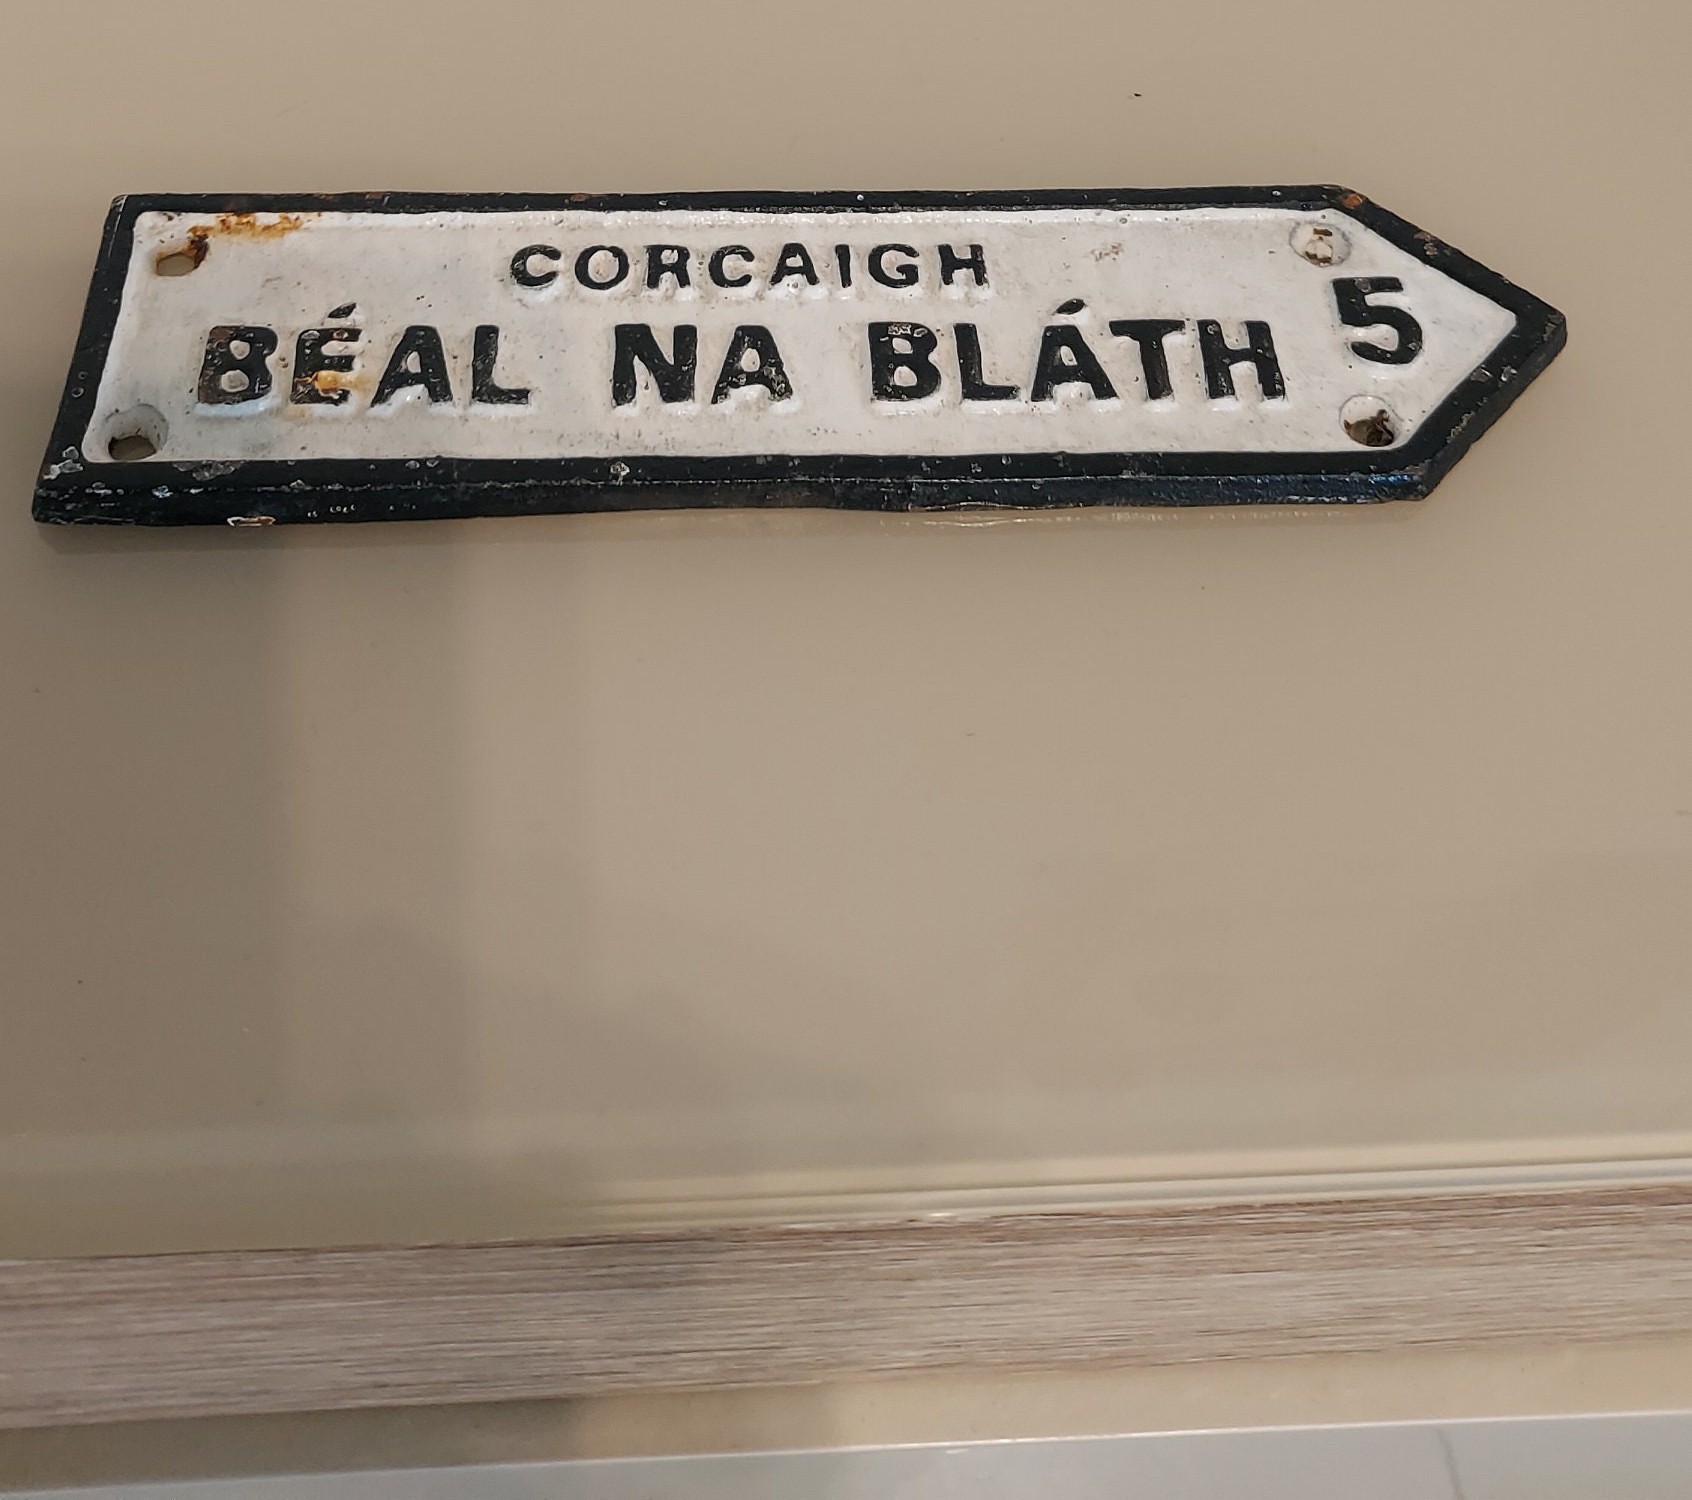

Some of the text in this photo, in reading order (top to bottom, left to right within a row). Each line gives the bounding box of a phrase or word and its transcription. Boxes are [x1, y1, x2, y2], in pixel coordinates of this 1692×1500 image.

[510, 243, 990, 289] CORCAIGH
[198, 298, 1287, 407] BÉAL NA BLÁTH
[1331, 276, 1423, 365] 5
